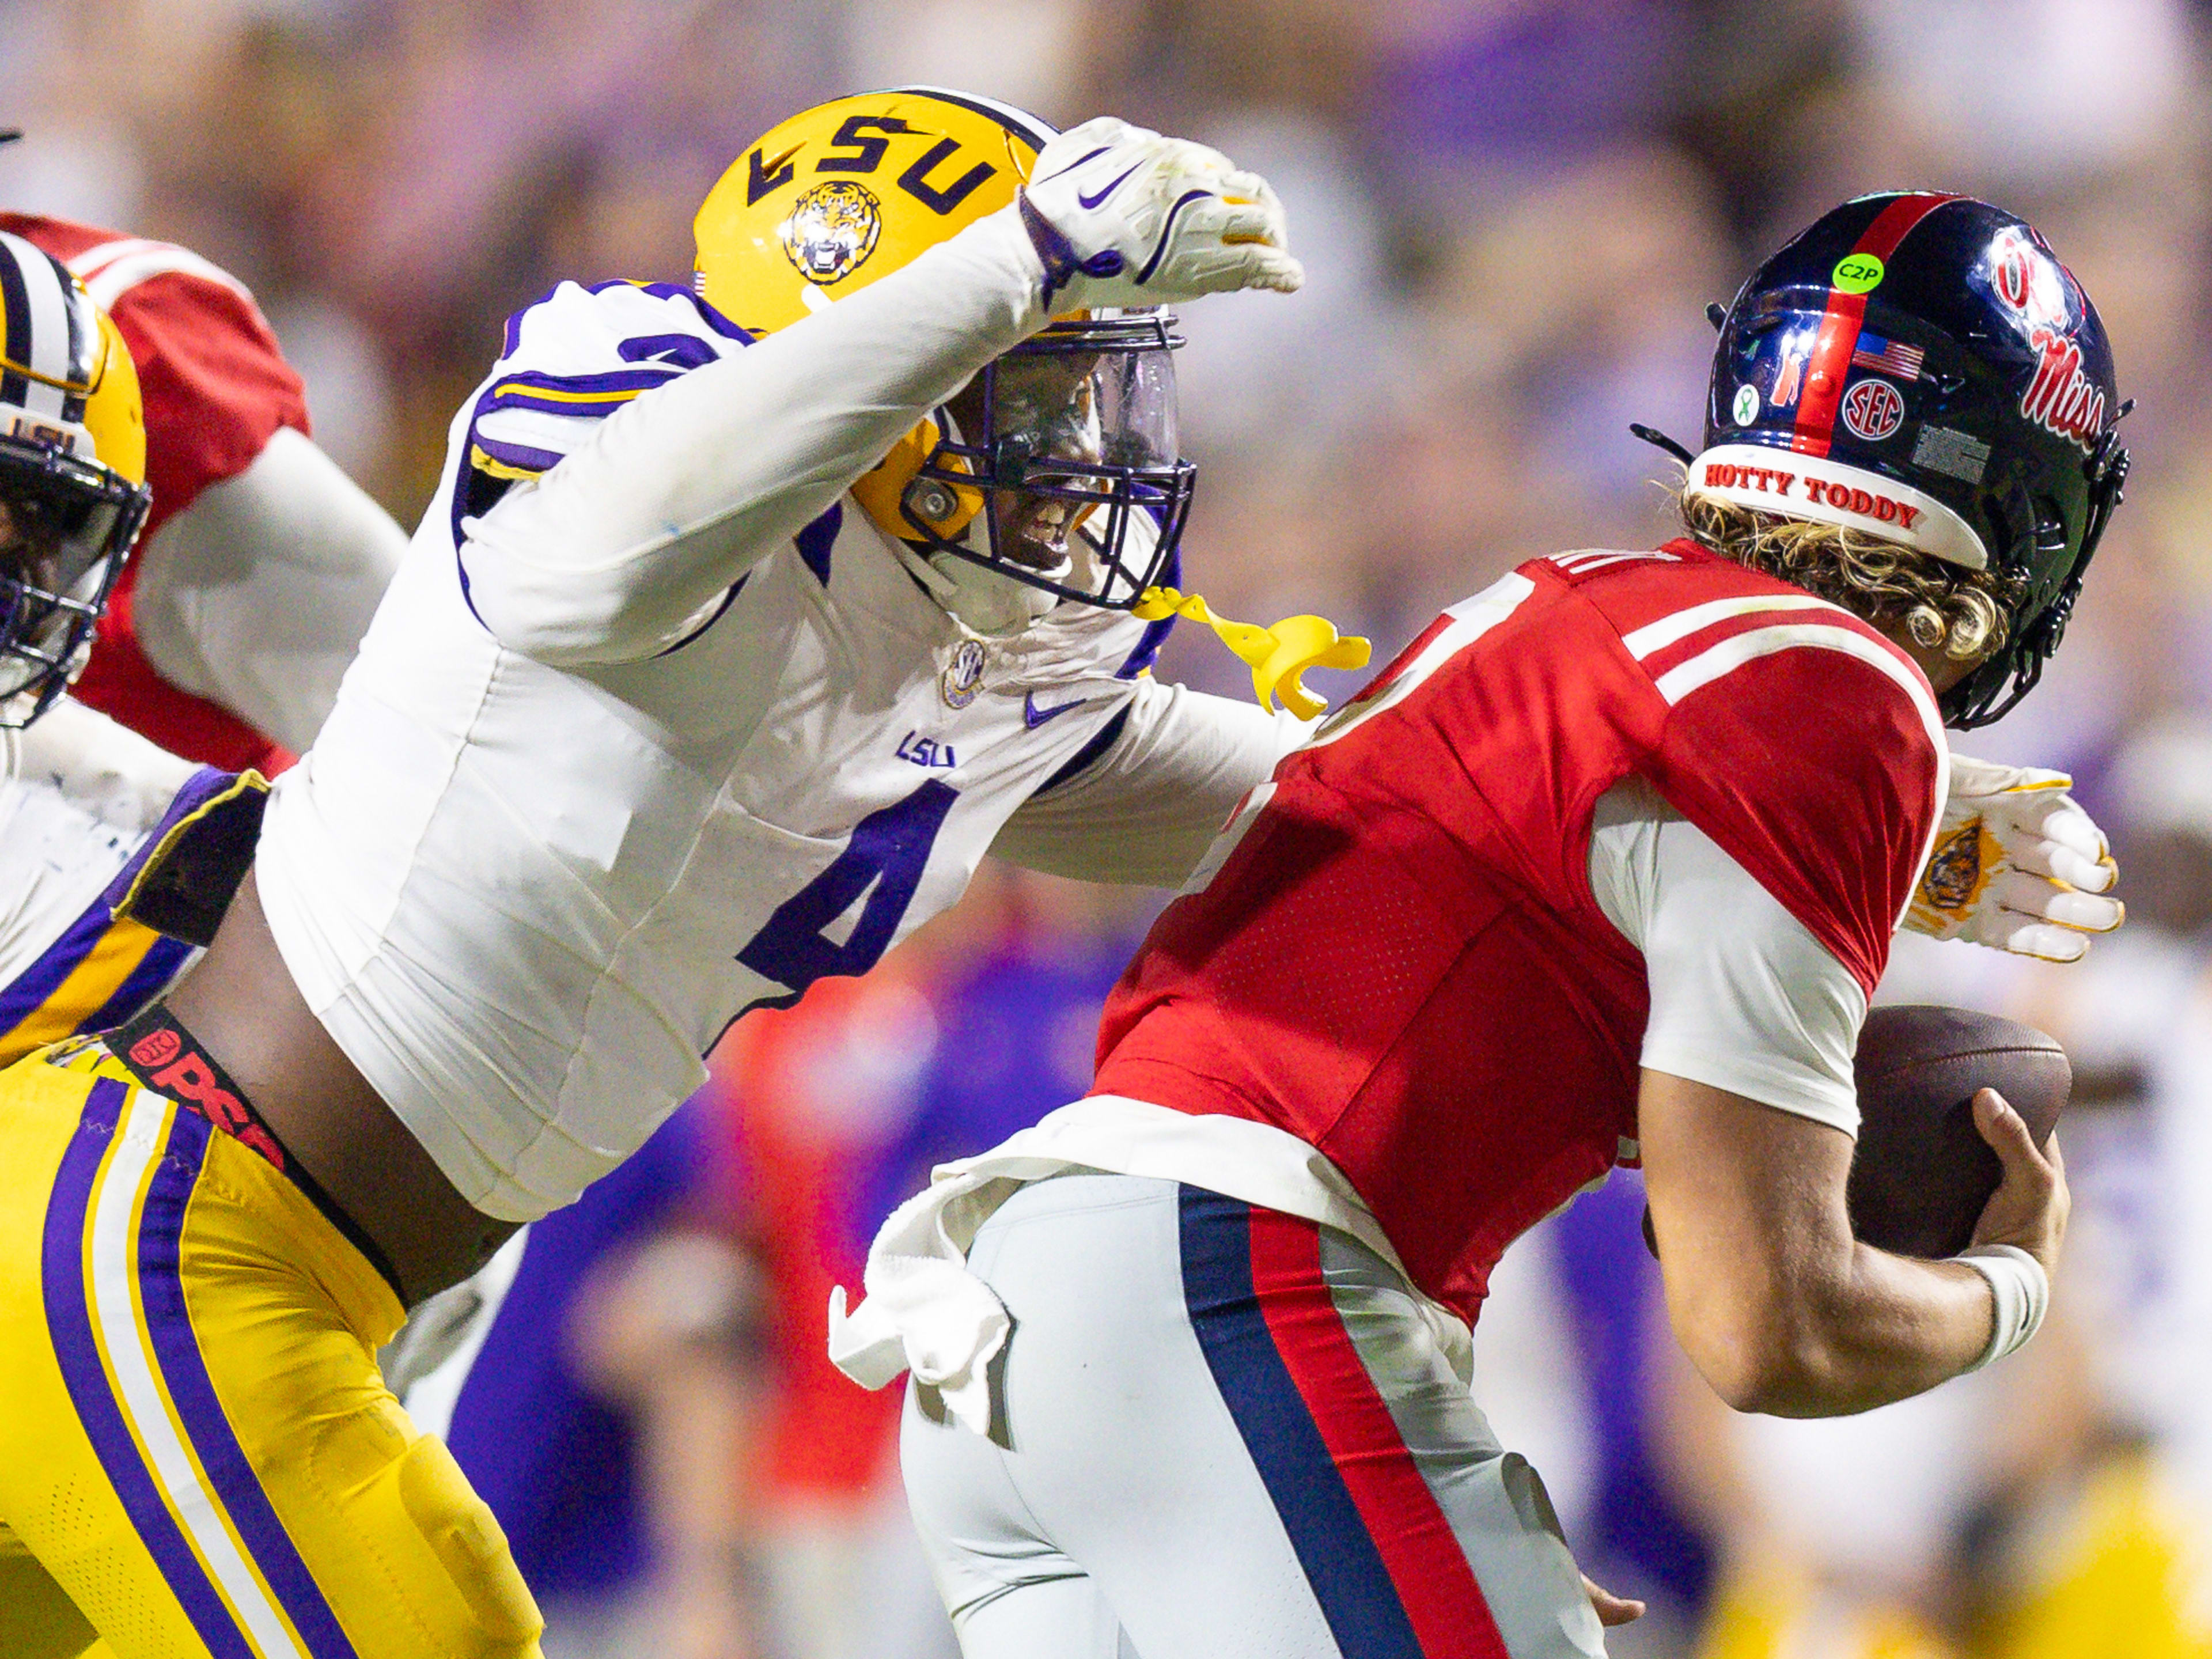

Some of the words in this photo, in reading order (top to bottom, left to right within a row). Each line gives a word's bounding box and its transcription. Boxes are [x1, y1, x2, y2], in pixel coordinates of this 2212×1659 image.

[748, 116, 997, 215] LSU
[1839, 263, 1879, 281] C2P
[1847, 384, 1900, 435] SEC
[1705, 464, 1794, 494] HOTTY
[1805, 477, 1919, 529] TODDY
[896, 730, 956, 768] LSU
[734, 778, 961, 992] 4
